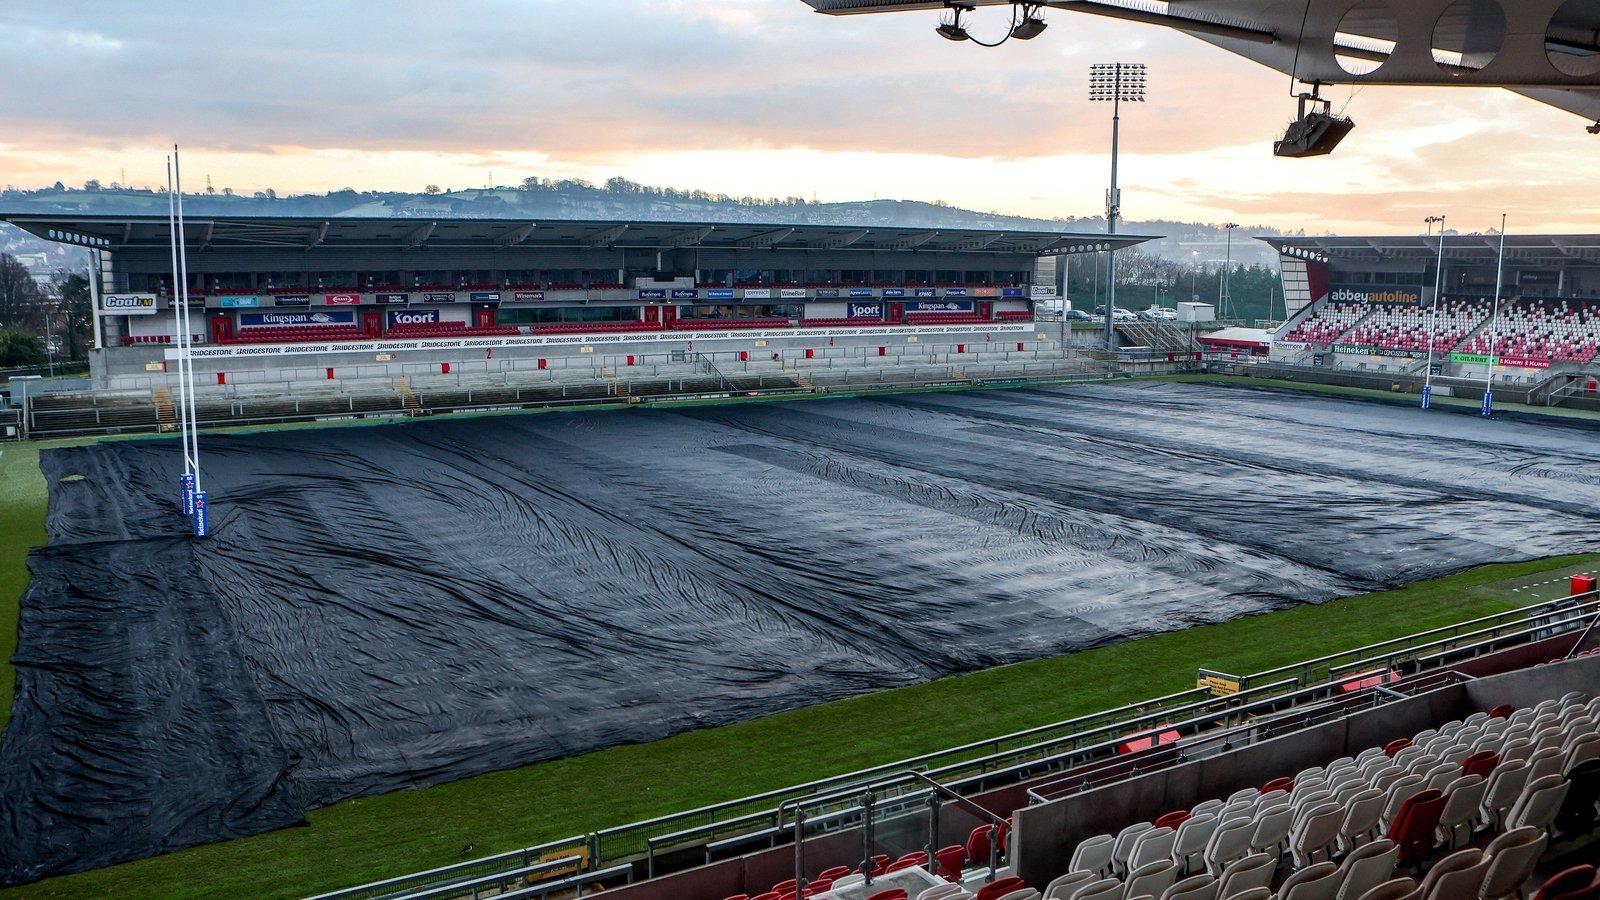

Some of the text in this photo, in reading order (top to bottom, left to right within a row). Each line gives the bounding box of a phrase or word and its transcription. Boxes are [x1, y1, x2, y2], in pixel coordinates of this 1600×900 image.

[918, 302, 945, 310] Kingspan
[263, 313, 307, 324] Kingspan
[688, 341, 692, 351] 3
[829, 337, 834, 346] 4
[1273, 342, 1302, 350] Tobermore
[486, 348, 492, 359] 2
[1334, 345, 1369, 354] Heineken
